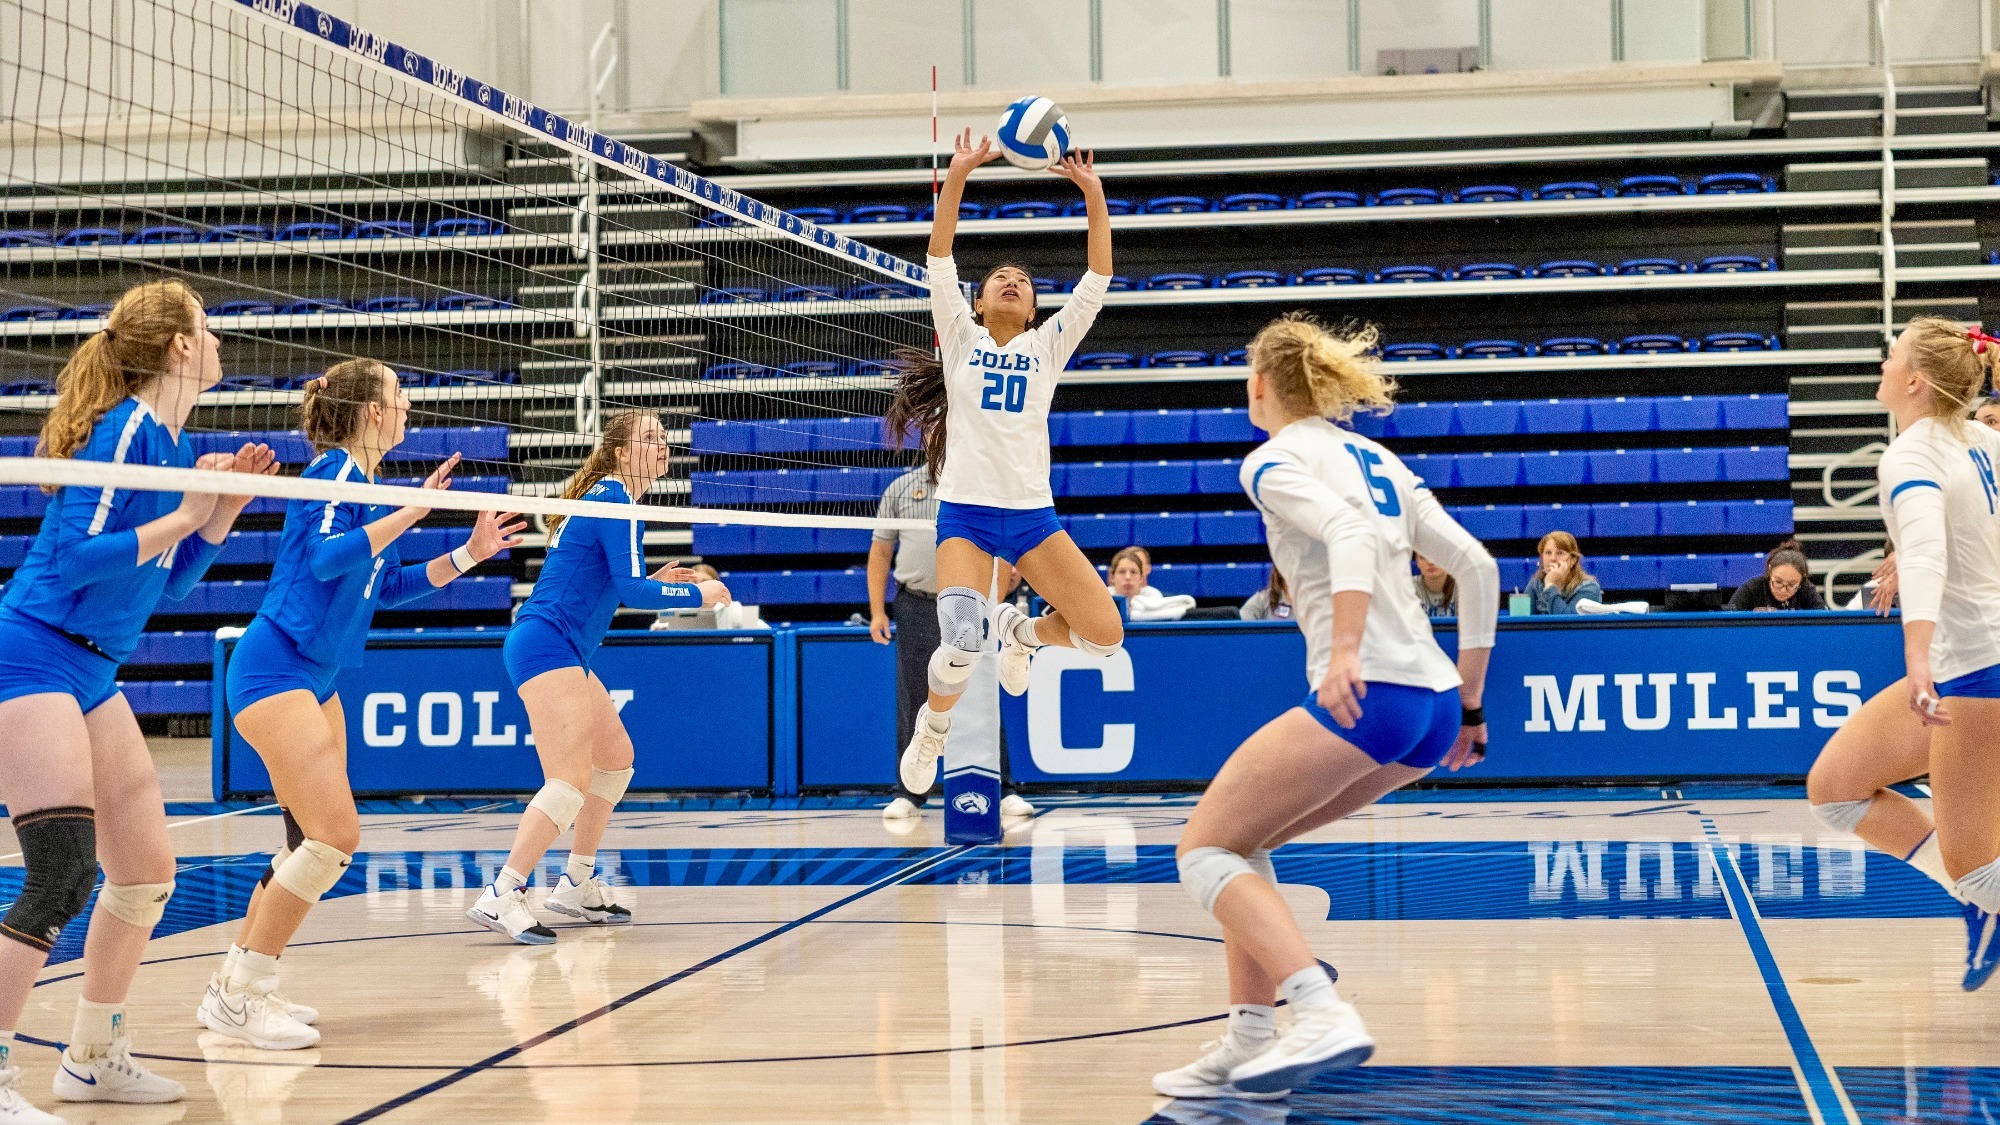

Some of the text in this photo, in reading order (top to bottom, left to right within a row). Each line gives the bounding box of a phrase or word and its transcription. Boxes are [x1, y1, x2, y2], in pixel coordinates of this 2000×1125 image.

[349, 25, 389, 64] COLBY
[432, 61, 467, 97] COLBY
[502, 94, 534, 126] COLBY
[566, 121, 594, 151] COLBY
[623, 143, 649, 174] COLBY
[674, 169, 698, 194] COLBY
[981, 372, 1028, 413] 20
[1344, 443, 1402, 517] 15
[362, 690, 634, 747] COL
[1027, 645, 1135, 774] C
[1523, 670, 1863, 732] MULES
